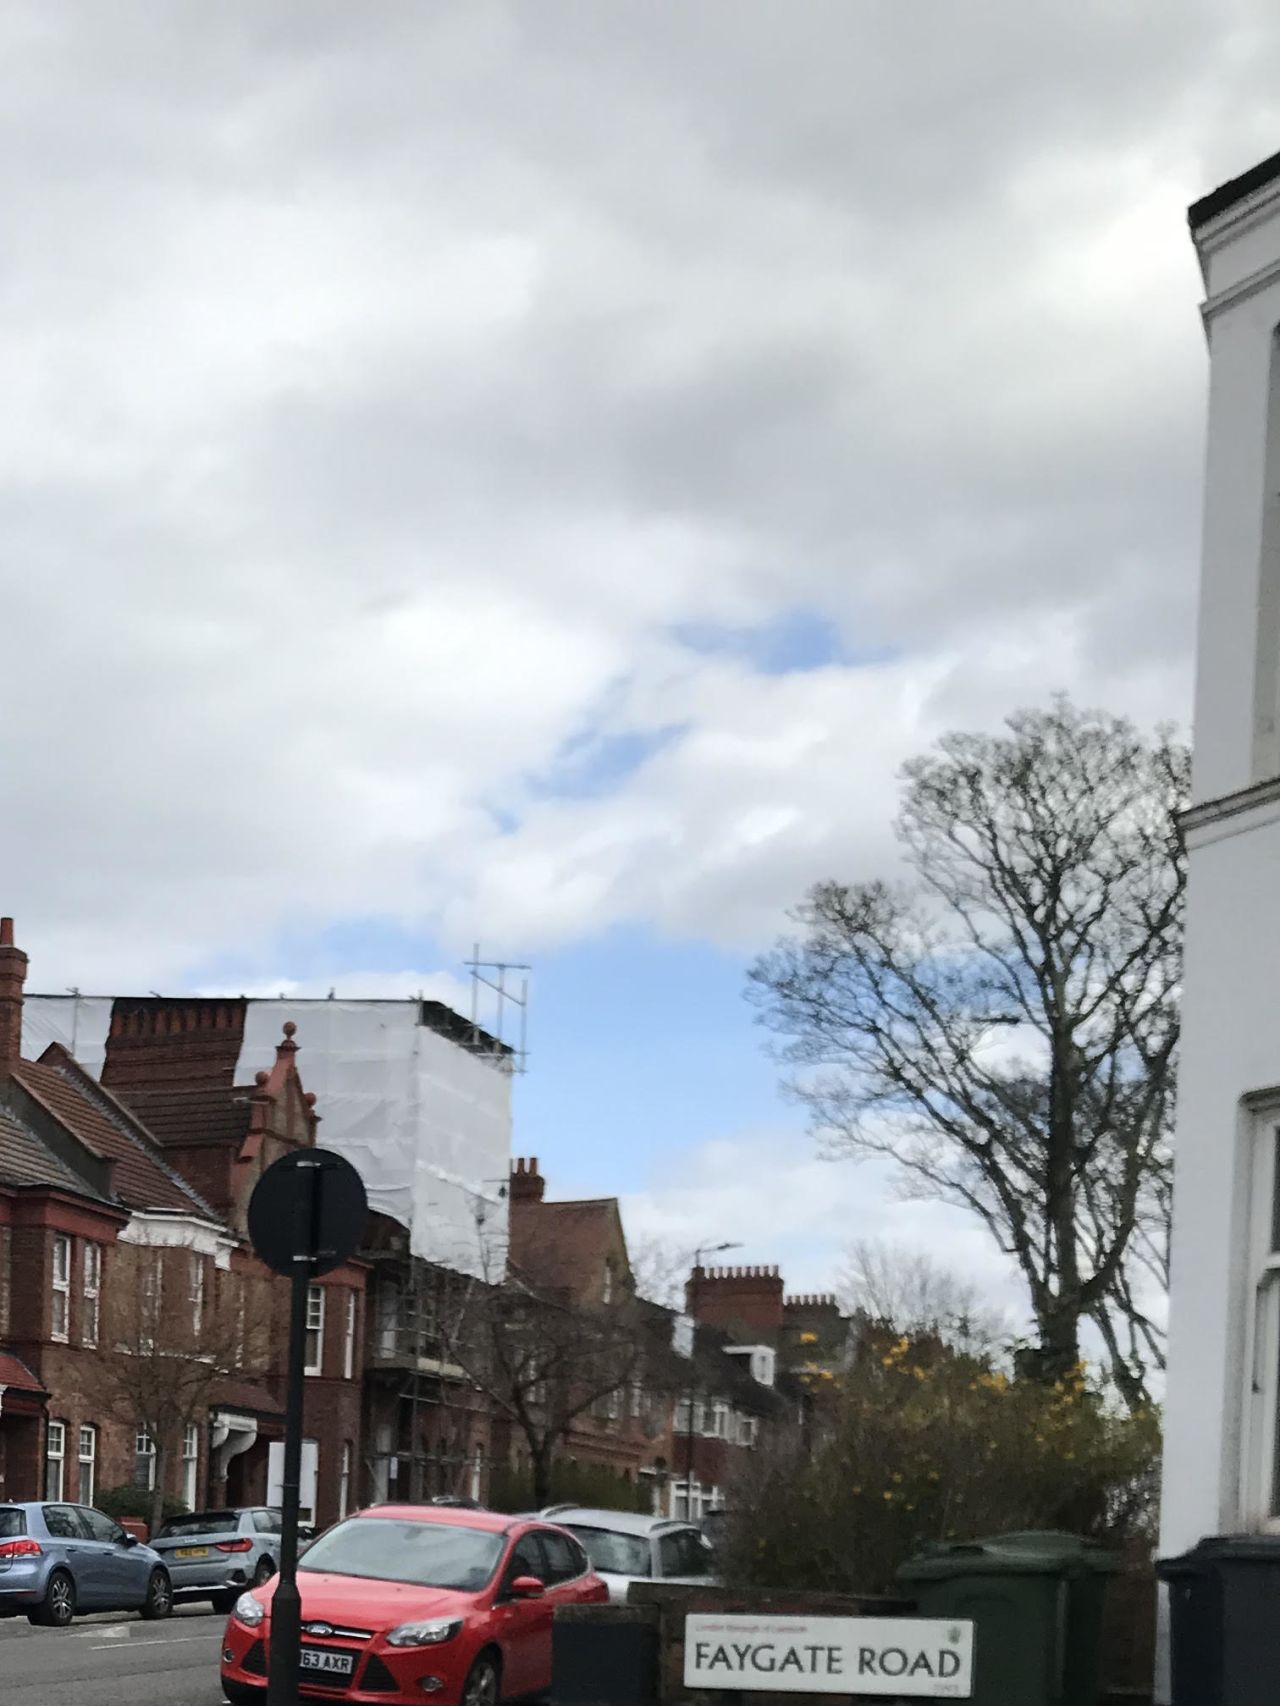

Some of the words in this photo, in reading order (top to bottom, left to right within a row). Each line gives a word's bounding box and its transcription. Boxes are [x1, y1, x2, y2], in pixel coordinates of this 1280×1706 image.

[300, 1652, 320, 1668] 63
[323, 1655, 350, 1671] AXR
[695, 1642, 842, 1674] FAYGATE
[857, 1647, 961, 1678] ROAD
